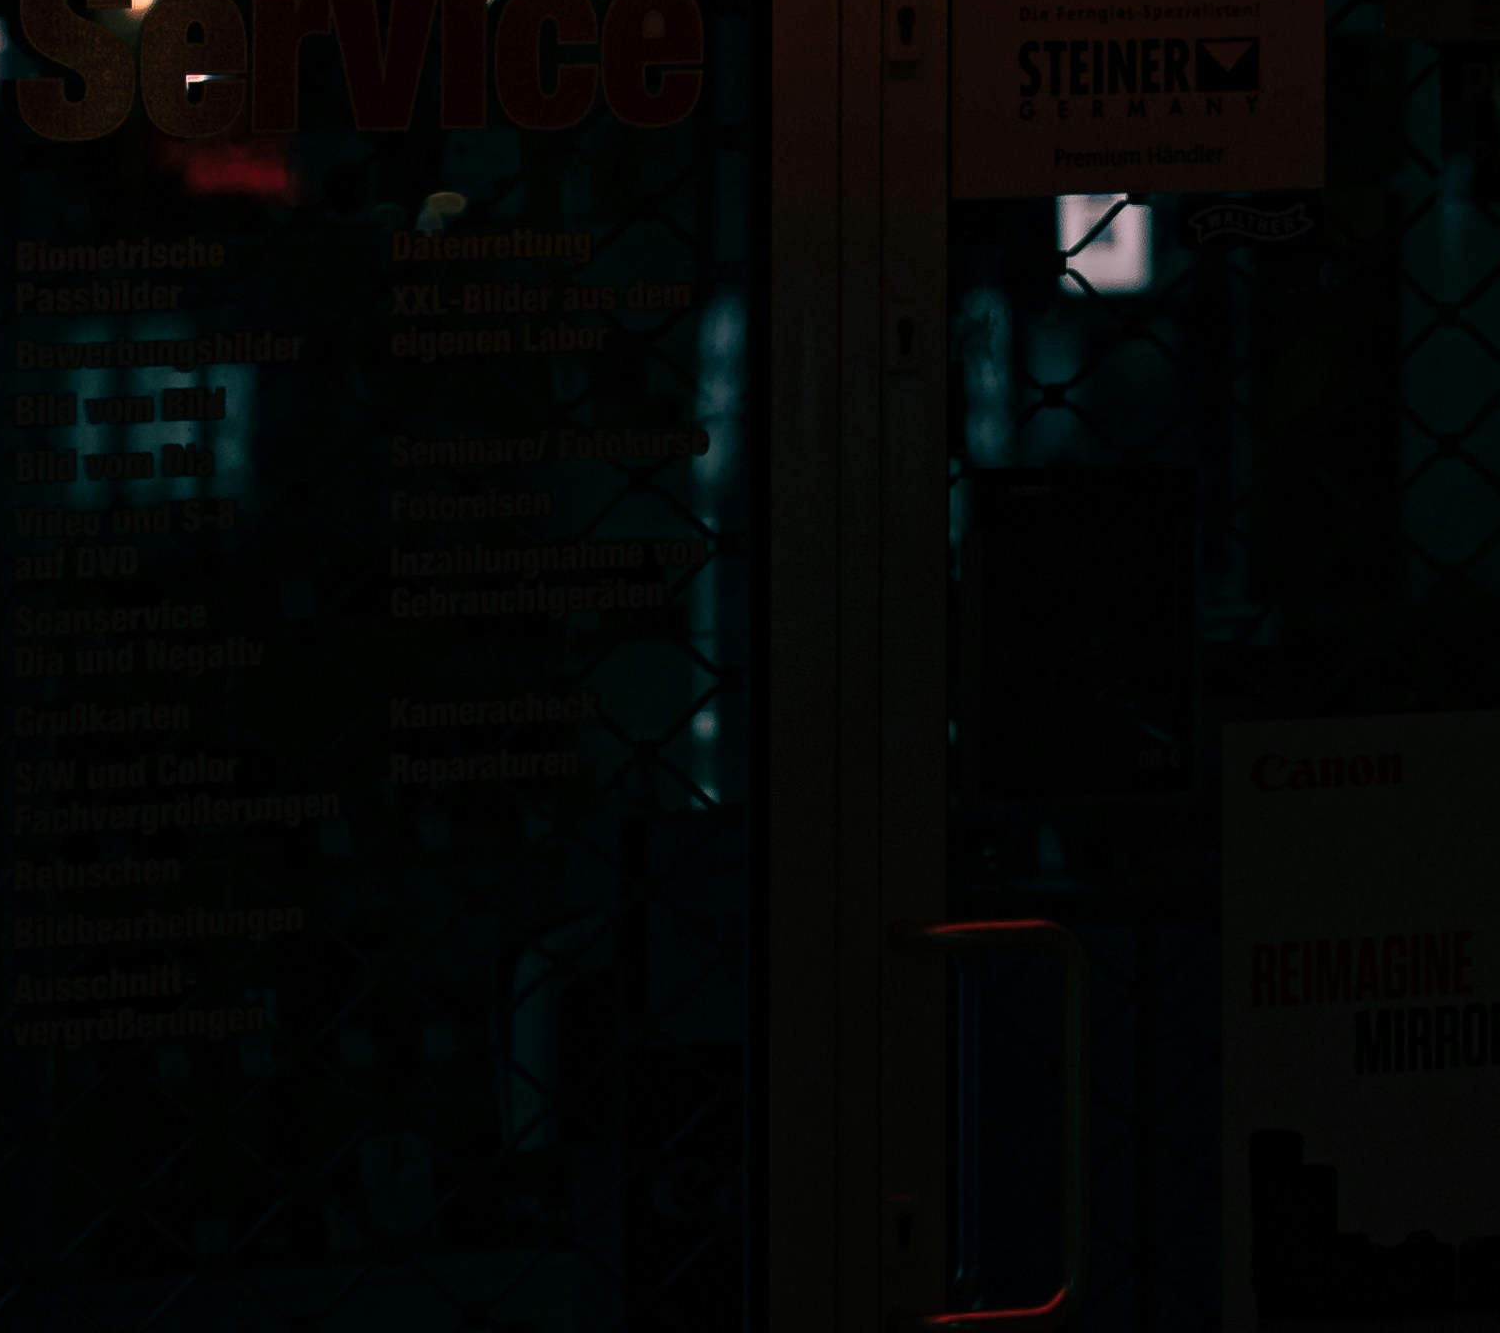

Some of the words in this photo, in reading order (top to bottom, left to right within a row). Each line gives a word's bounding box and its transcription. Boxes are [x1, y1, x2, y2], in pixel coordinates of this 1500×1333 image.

[1018, 5, 1049, 23] Die
[1017, 37, 1190, 97] STEINER
[1018, 95, 1261, 121] GERMANY
[1053, 147, 1141, 169] Premium
[1147, 144, 1226, 167] Händler
[15, 239, 226, 274] Biometrische
[390, 228, 593, 268] Datenrettung
[15, 282, 183, 315] Passbilder
[561, 283, 617, 312] aus
[626, 279, 692, 311] dem
[15, 333, 305, 370] Bewerbungsbilder
[390, 327, 512, 361] eigenen
[521, 323, 609, 354] Labor
[15, 393, 76, 426] Bild
[85, 396, 154, 425] vom
[162, 387, 225, 421] Bild
[15, 449, 76, 483] Bild
[85, 451, 154, 481] vom
[111, 501, 172, 535] und
[75, 545, 140, 579] DVD
[75, 643, 137, 676] und
[86, 756, 148, 790] und
[156, 750, 242, 787] Color
[1251, 751, 1404, 793] Canon
[1251, 930, 1474, 1009] REIMAGINE
